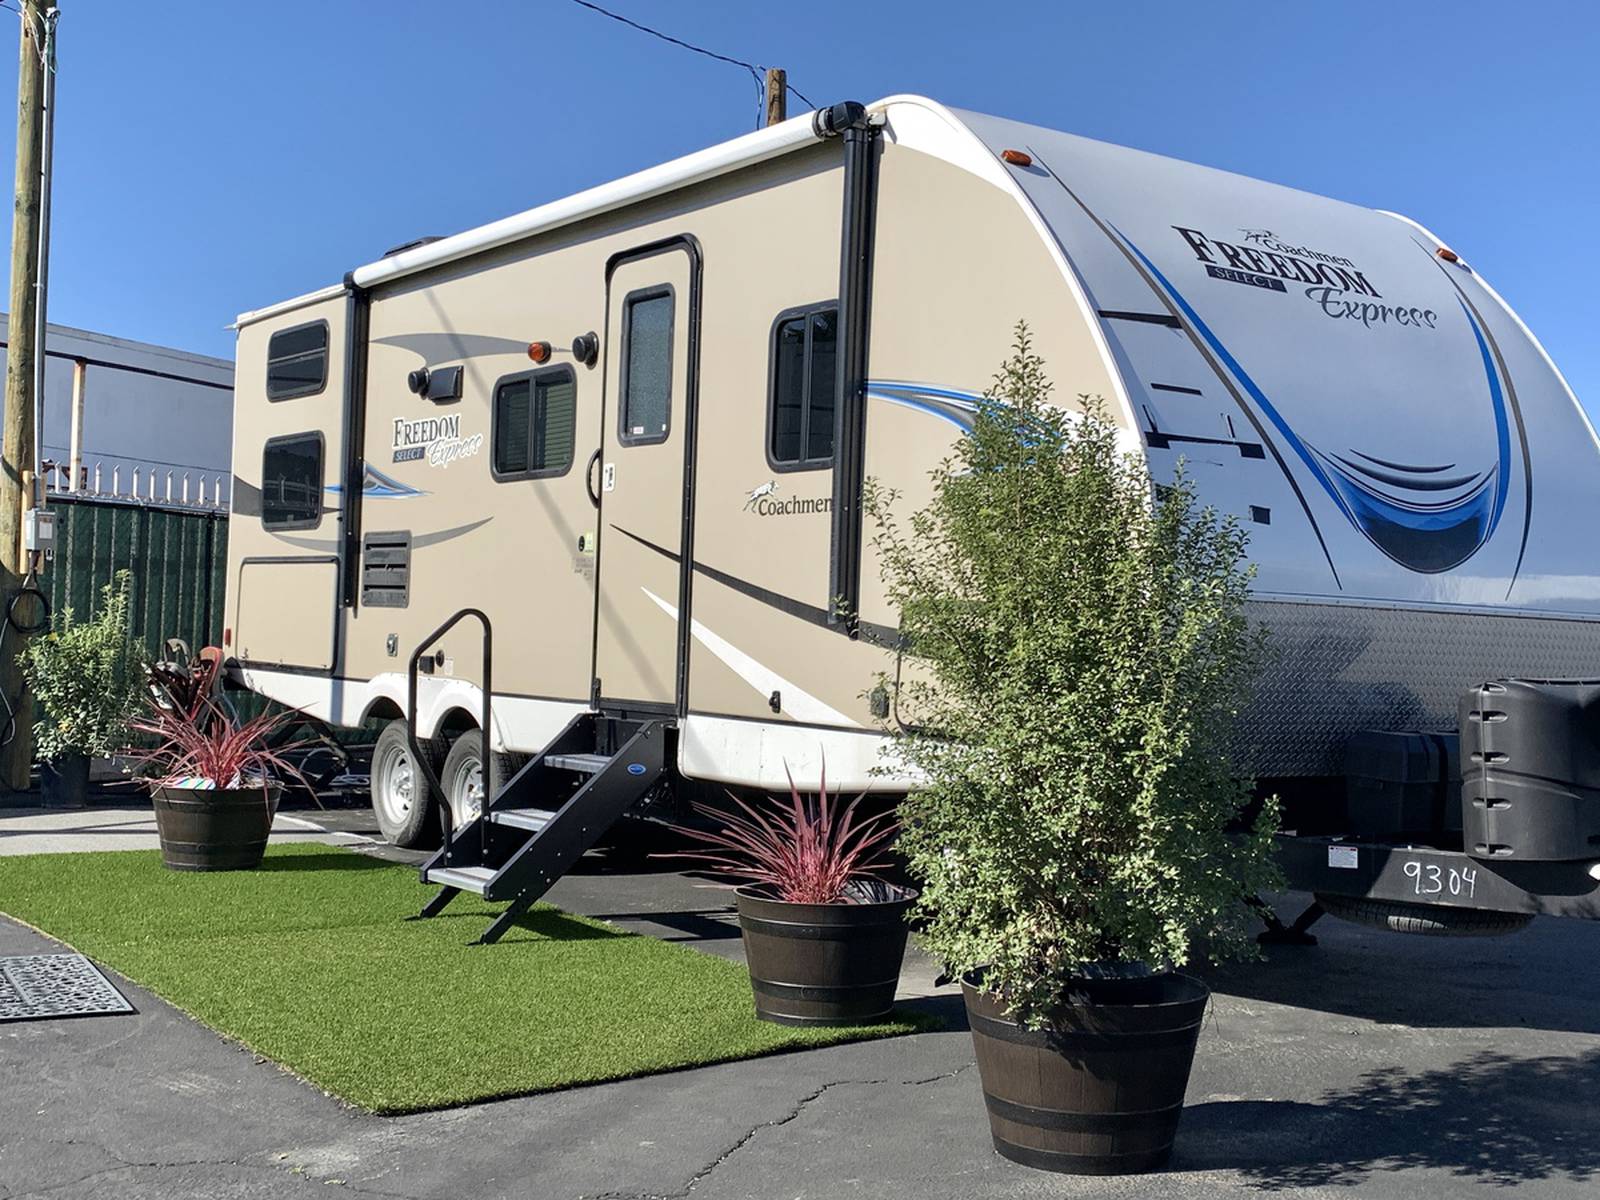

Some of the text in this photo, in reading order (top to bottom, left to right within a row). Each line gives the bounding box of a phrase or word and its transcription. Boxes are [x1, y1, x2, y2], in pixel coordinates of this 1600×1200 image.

[1171, 225, 1383, 299] FREEDOM
[1263, 238, 1355, 268] Coachmen
[1215, 267, 1275, 291] SELECT
[1304, 287, 1437, 329] Express
[393, 415, 460, 447] FREEDOM
[395, 448, 422, 461] SELECT
[427, 435, 482, 465] Express
[758, 495, 832, 516] Coachmen
[1403, 861, 1477, 899] 9304
